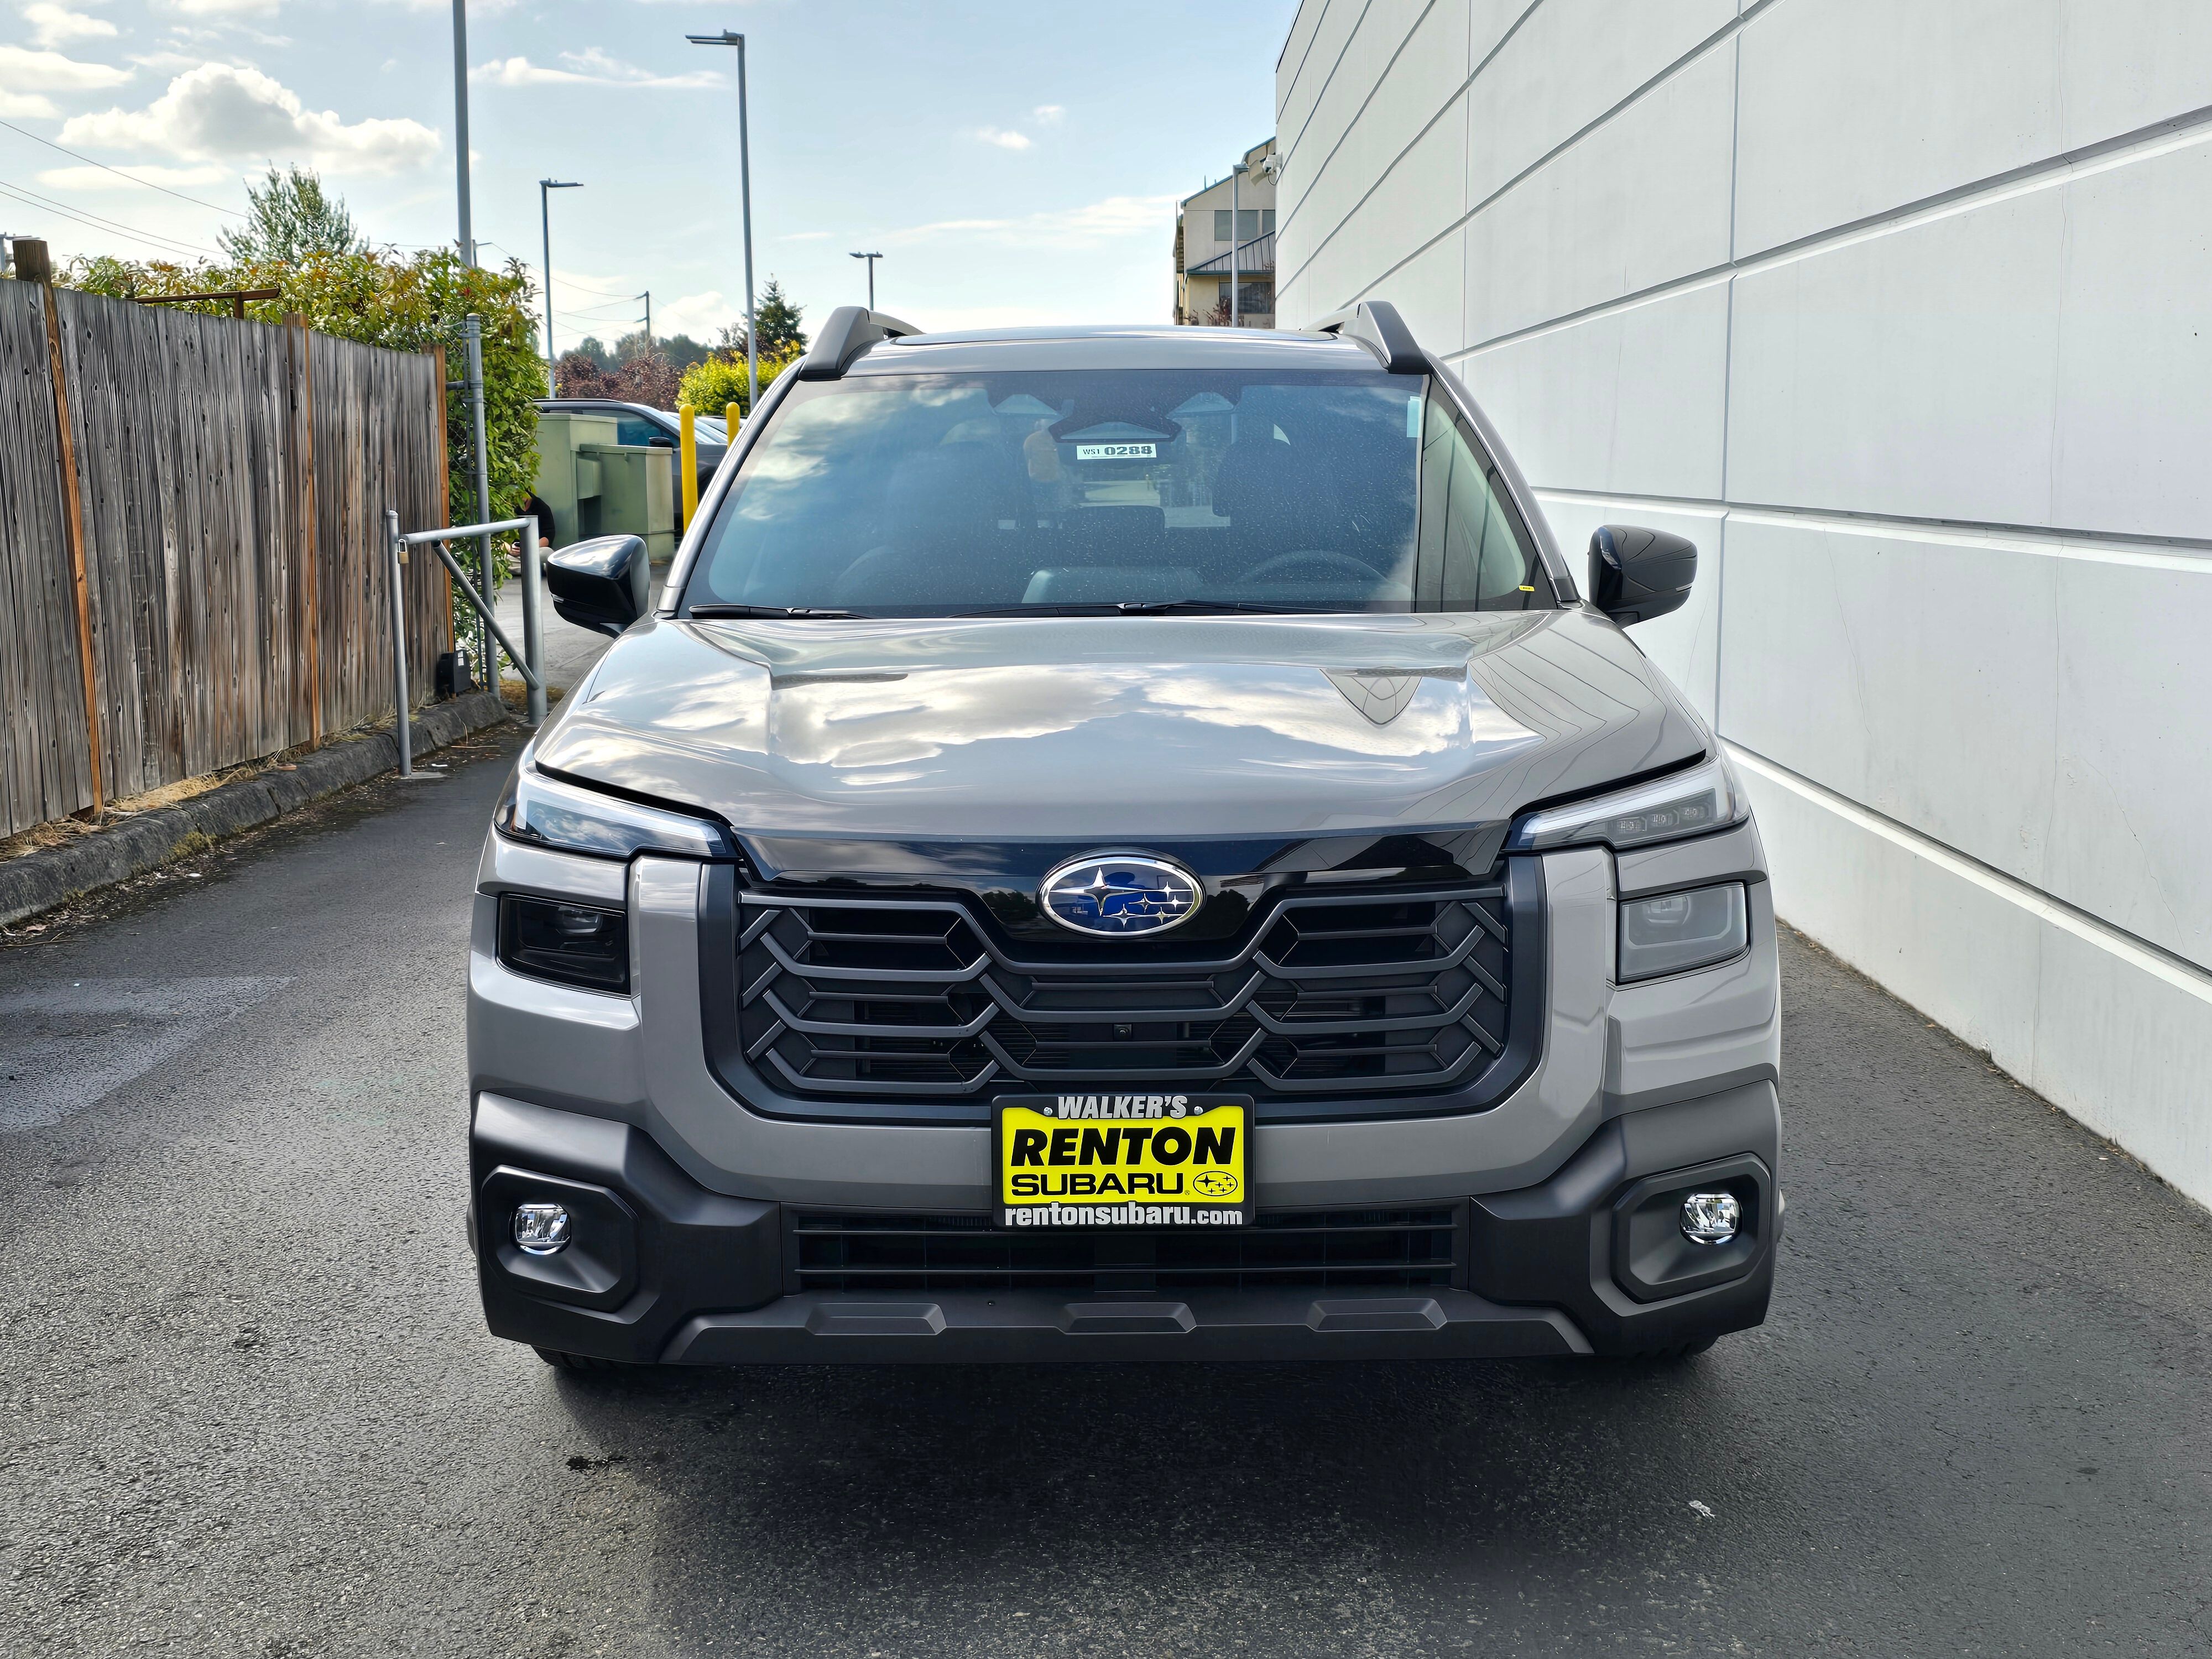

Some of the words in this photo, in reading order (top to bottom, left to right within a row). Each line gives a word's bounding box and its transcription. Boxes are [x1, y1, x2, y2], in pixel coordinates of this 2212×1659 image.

[1104, 446, 1152, 455] 0288
[1058, 1095, 1187, 1119] WALKER'S
[1011, 1126, 1236, 1167] RENTON
[1011, 1173, 1183, 1196] SUBARU
[1005, 1202, 1243, 1226] rentonsubaru.com
